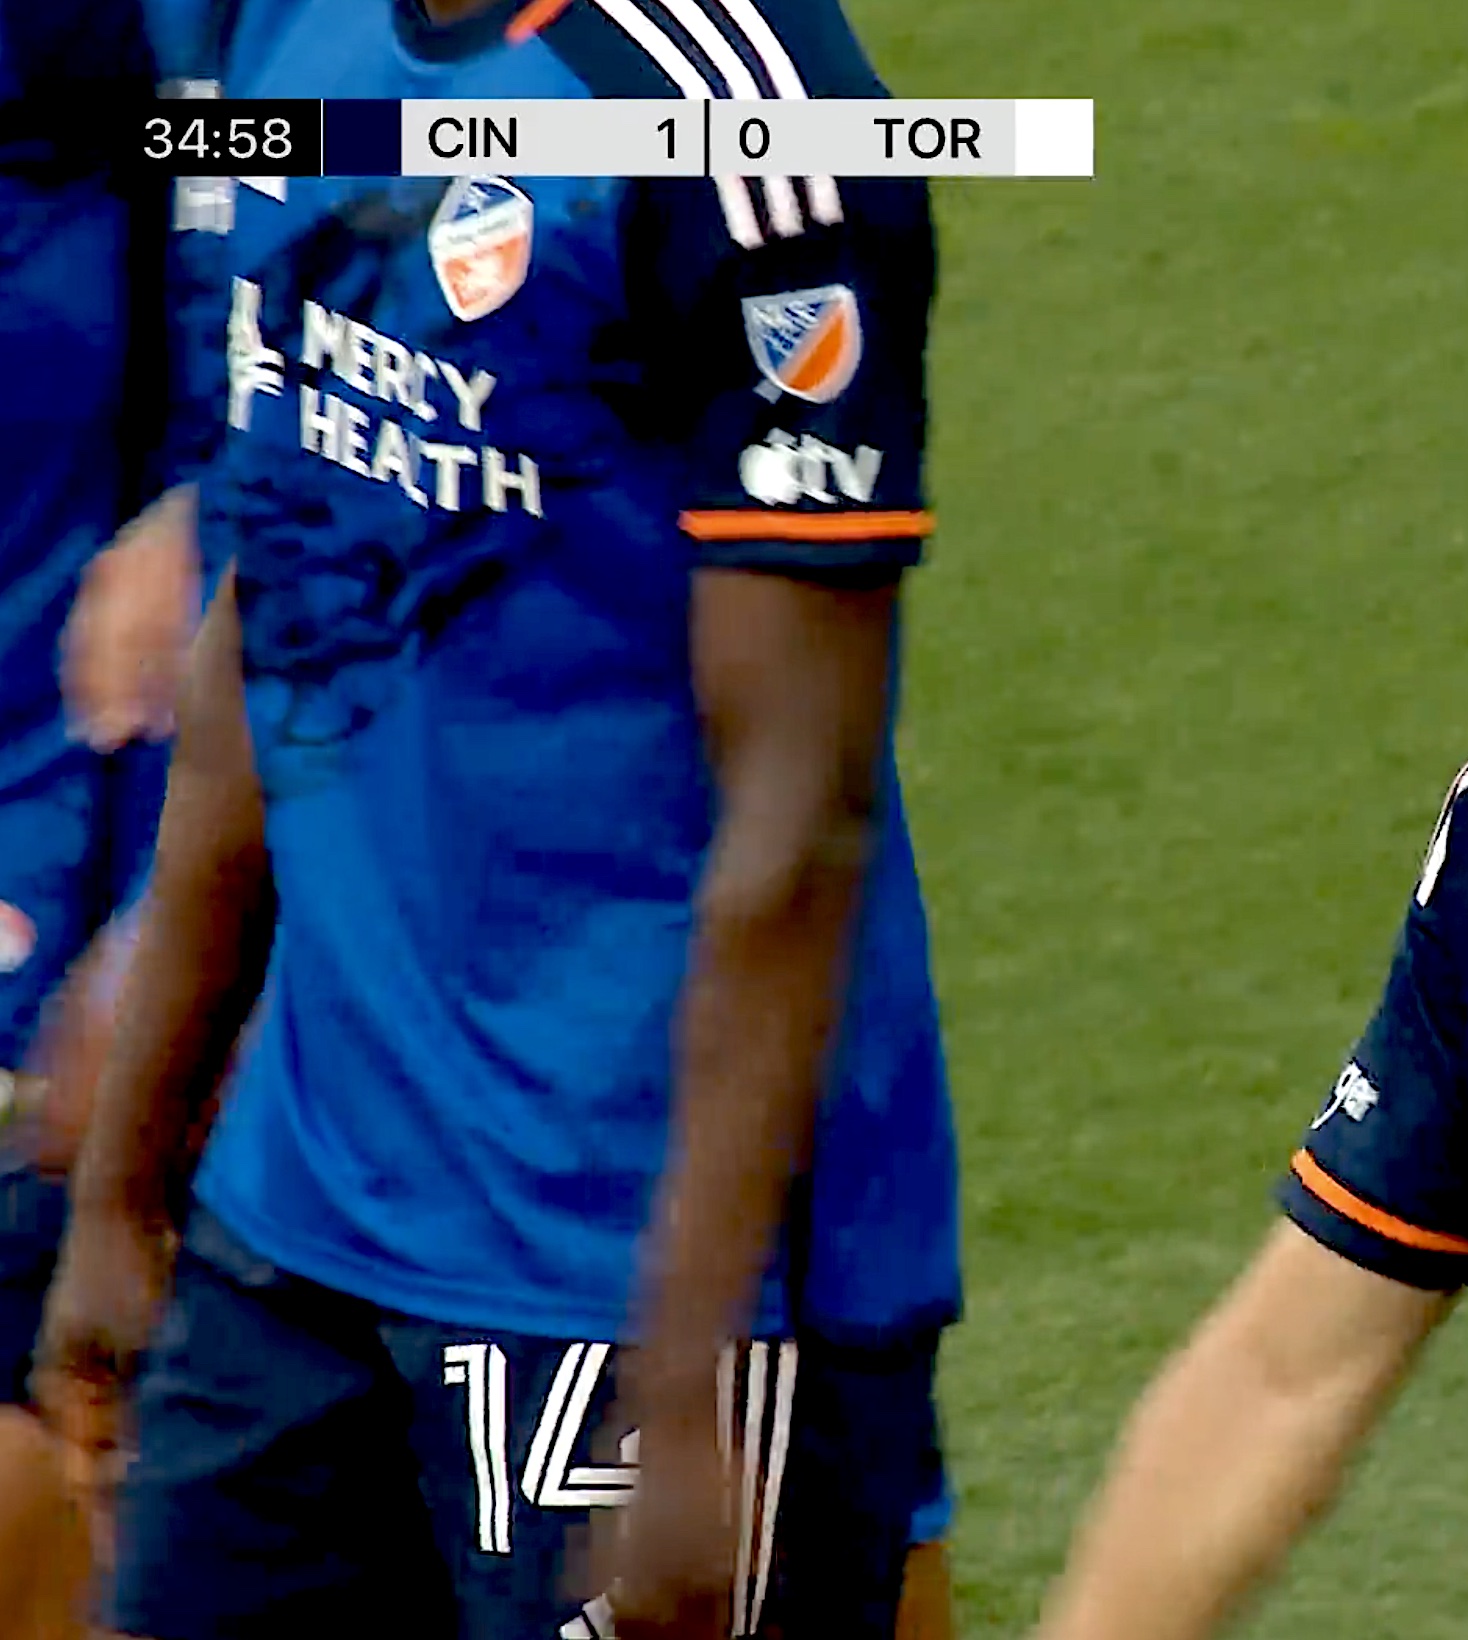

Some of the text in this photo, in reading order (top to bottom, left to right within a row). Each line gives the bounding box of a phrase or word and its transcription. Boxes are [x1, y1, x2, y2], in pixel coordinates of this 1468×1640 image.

[301, 299, 497, 432] MERCY
[300, 383, 543, 519] HEALTH
[443, 1341, 640, 1554] 14
